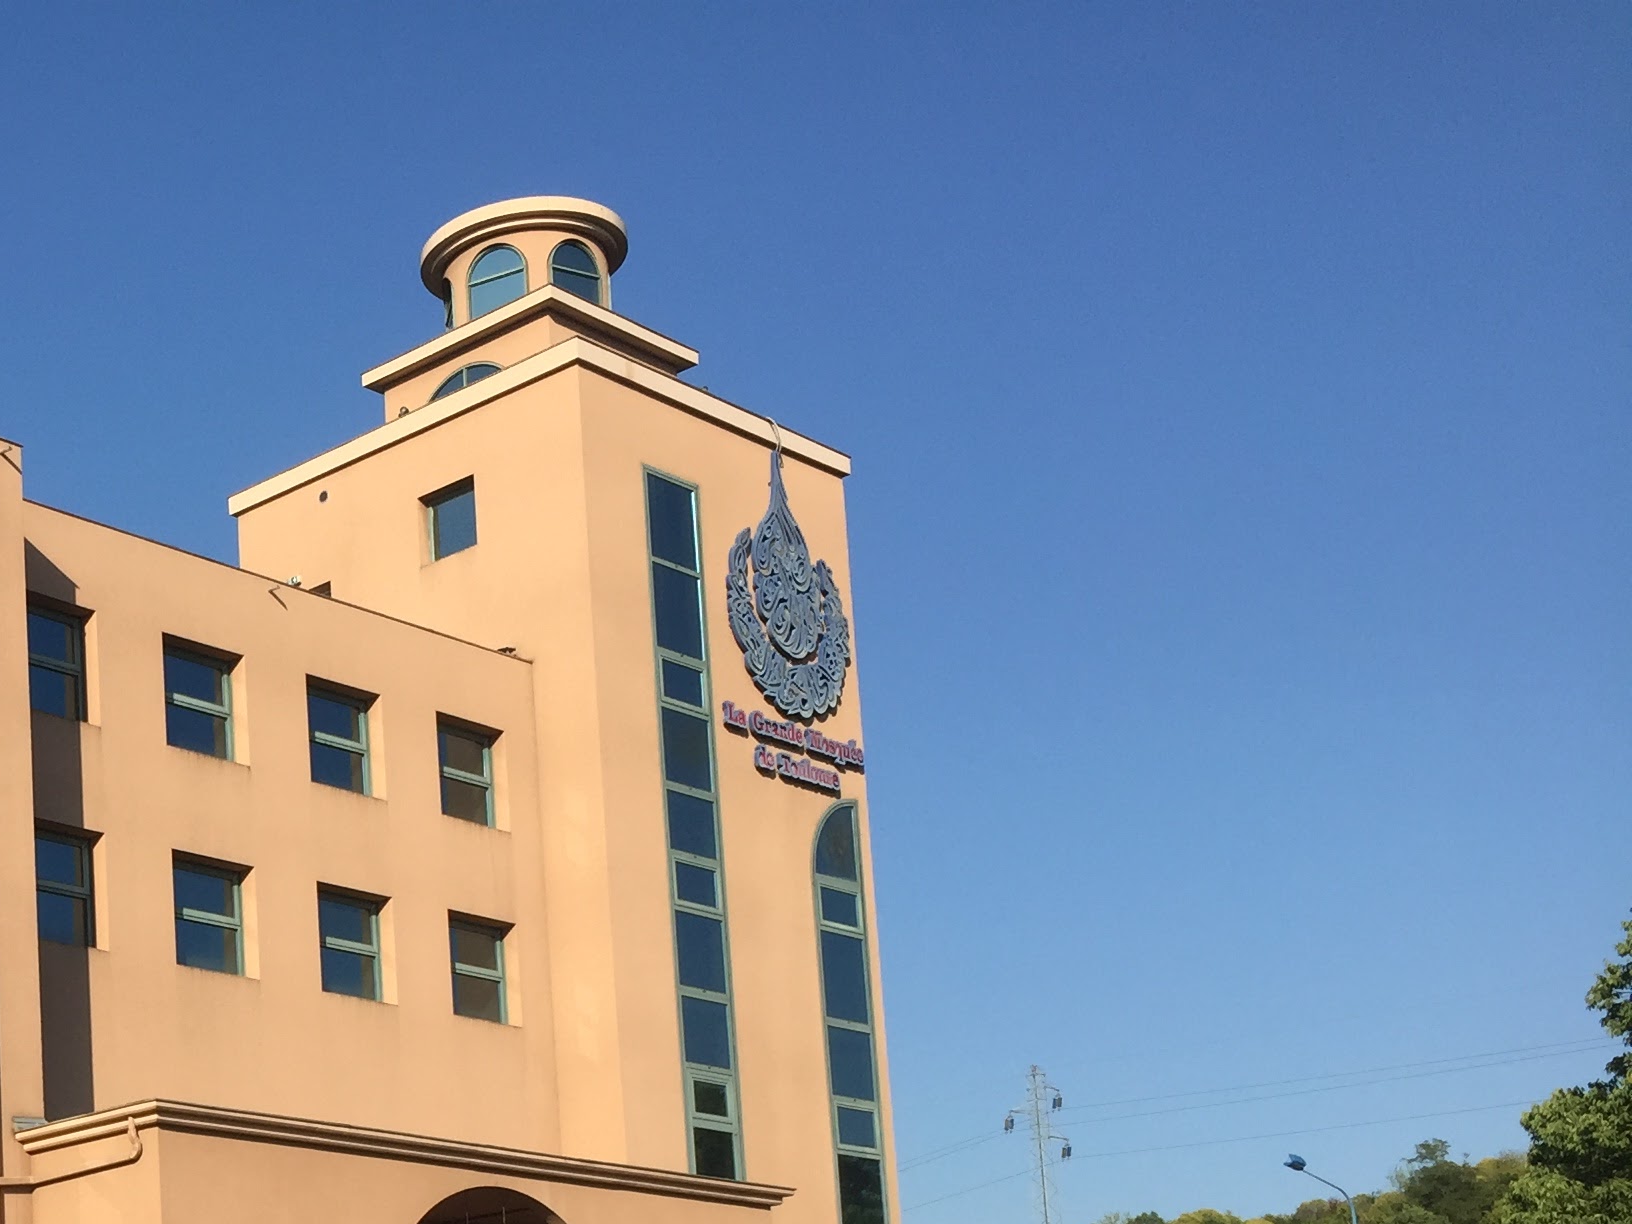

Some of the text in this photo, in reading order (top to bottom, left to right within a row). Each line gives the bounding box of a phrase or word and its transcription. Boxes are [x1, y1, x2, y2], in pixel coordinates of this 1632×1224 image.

[723, 701, 864, 766] La Grande Mosquée
[755, 744, 840, 791] de Toulouse
